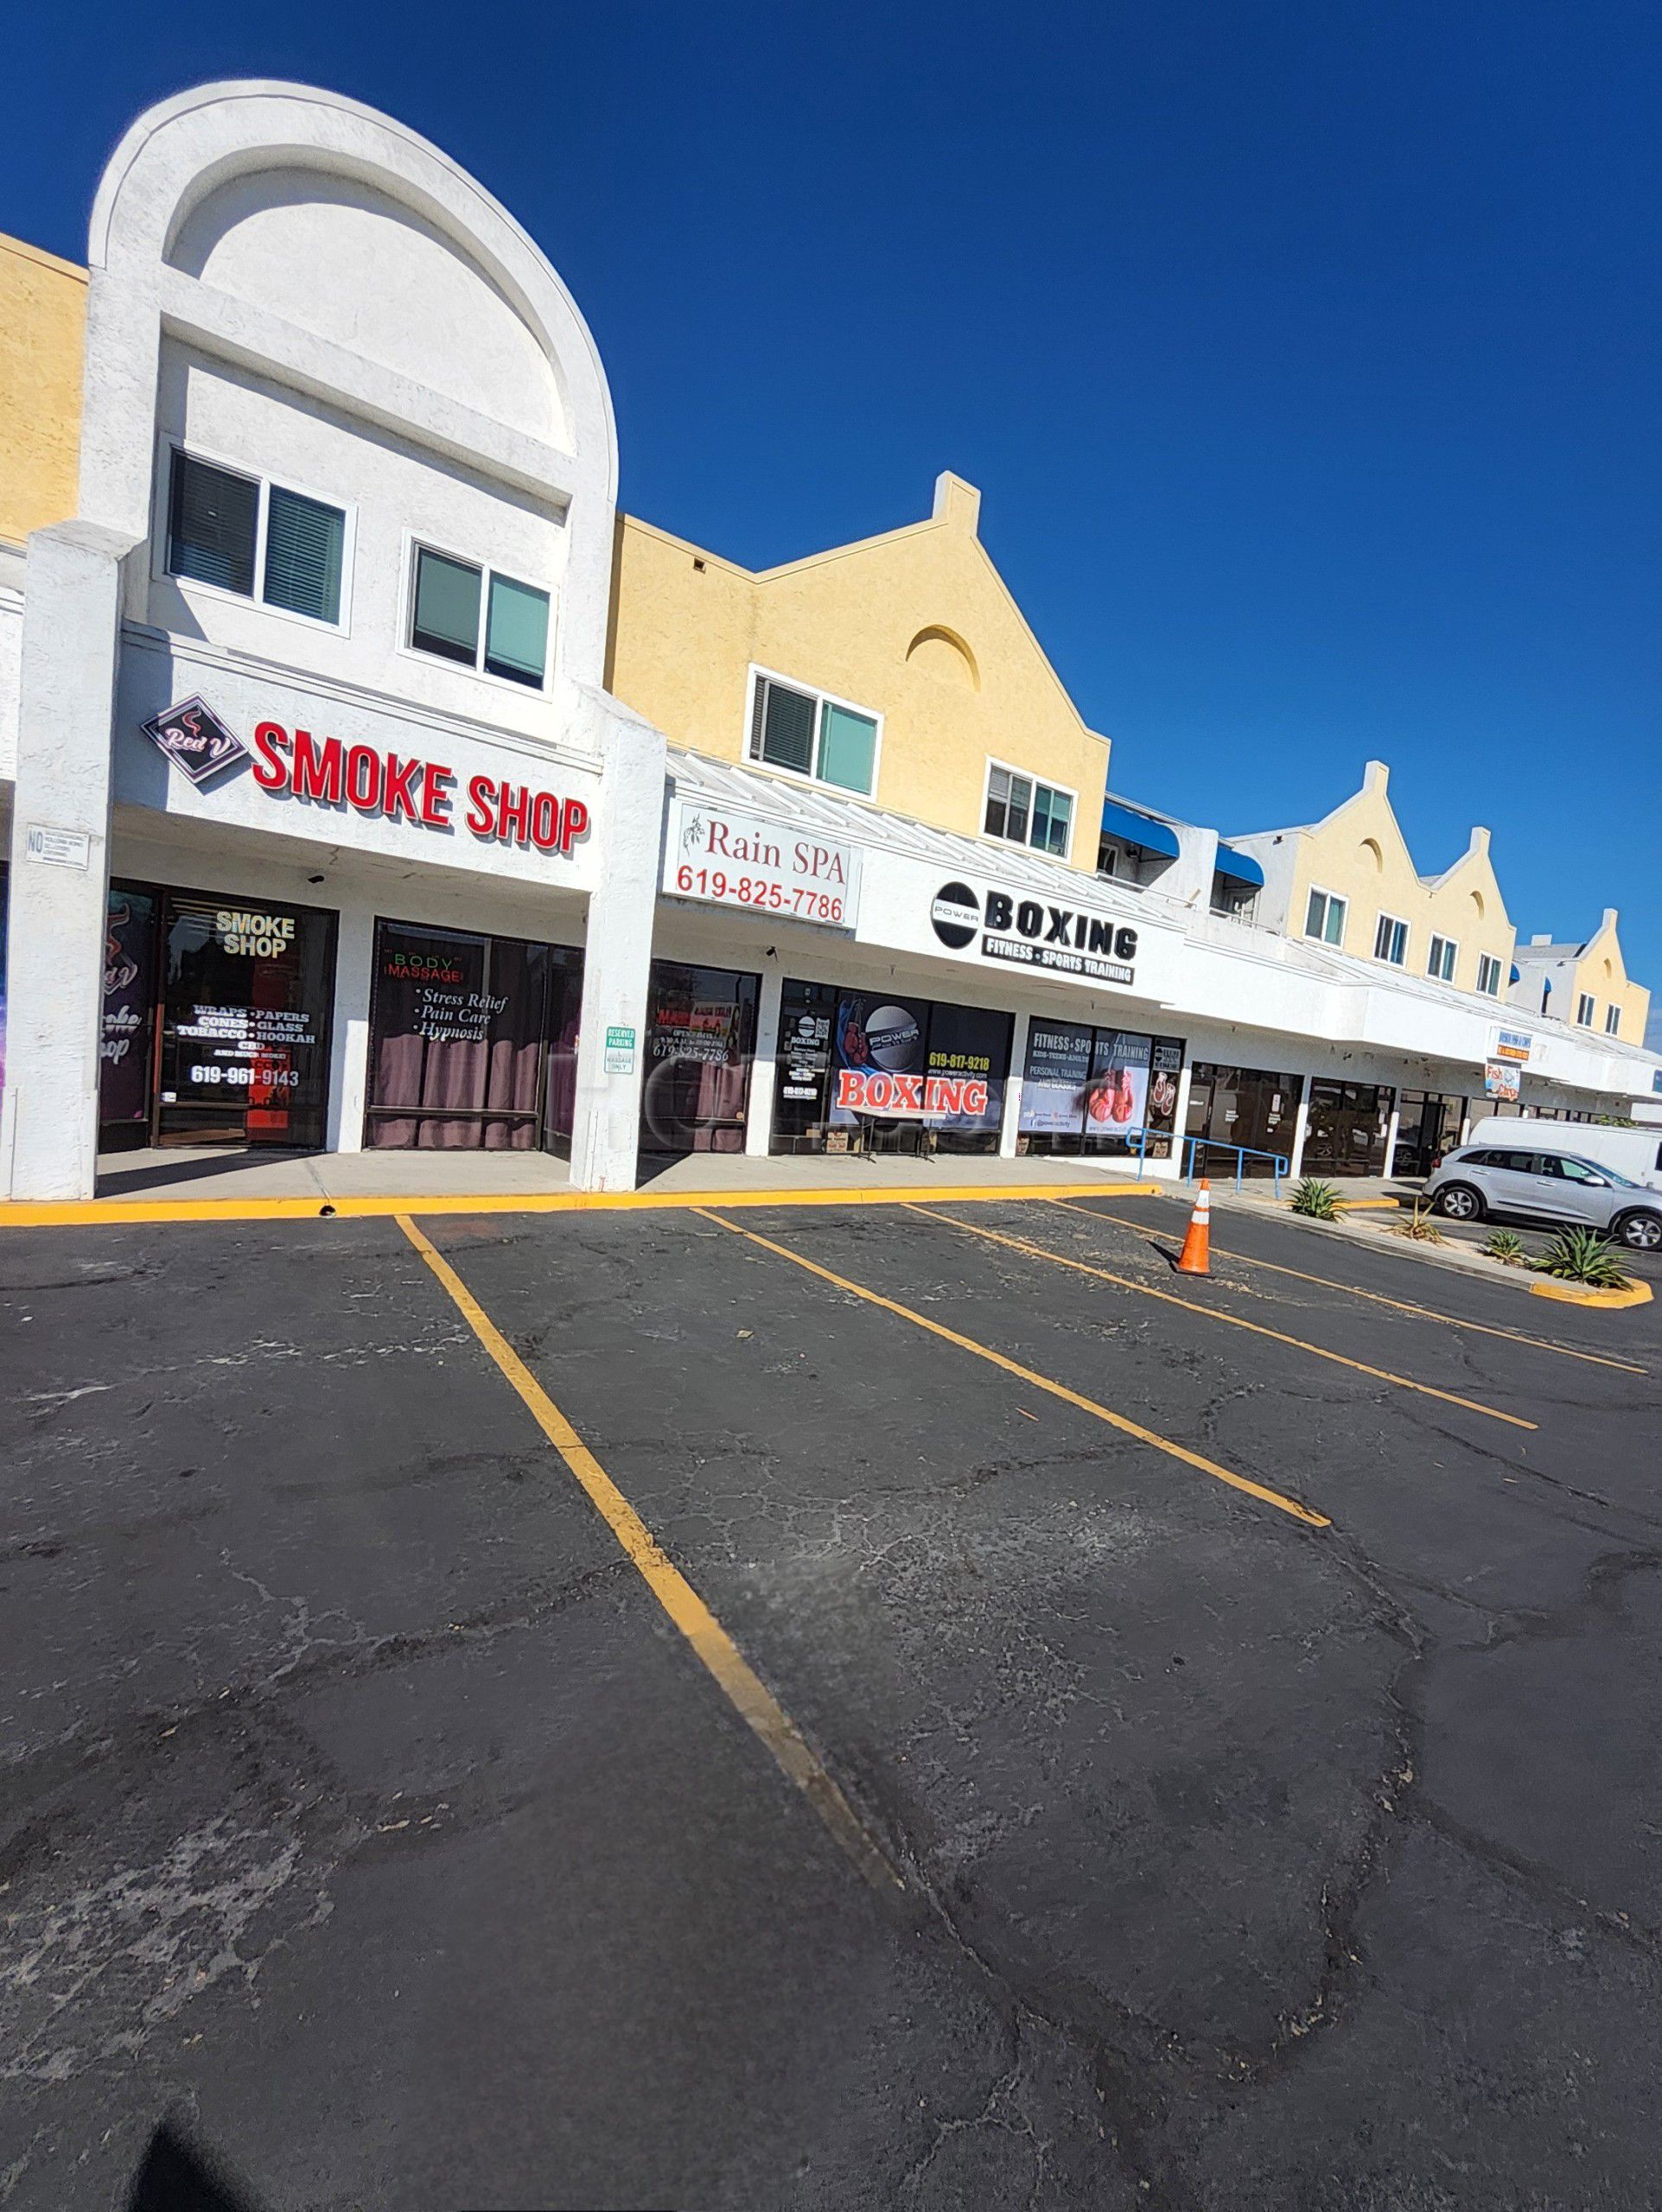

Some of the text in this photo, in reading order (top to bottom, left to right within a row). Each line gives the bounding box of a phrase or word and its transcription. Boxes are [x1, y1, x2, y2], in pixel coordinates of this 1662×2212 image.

[165, 728, 232, 759] Red V
[252, 721, 589, 853] SMOKE SHOP
[28, 830, 43, 854] NO
[705, 819, 845, 885] Rain SPA
[678, 865, 843, 921] 619-825-7786
[935, 907, 980, 922] POWER
[216, 911, 295, 939] SMOKE
[984, 890, 1138, 961] BOXING
[224, 934, 286, 958] SHOP
[395, 954, 452, 969] BODY
[987, 938, 1131, 982] FITNESS SPORTS TRAINING
[388, 963, 461, 982] MASSAGE
[423, 988, 508, 1014] Stress Relief
[193, 1005, 309, 1022] WRAPS PAPERS
[421, 1005, 491, 1025] Pain Care
[198, 1016, 303, 1033] CONES GLASS
[419, 1021, 484, 1041] Hypnosis
[608, 1028, 634, 1039] RESERVED
[176, 1025, 315, 1044] TOBACCO HOOKAH
[608, 1037, 633, 1047] PARKING
[791, 1036, 820, 1046] BOXING
[869, 1029, 920, 1046] POWER
[238, 1041, 265, 1051] CBD
[653, 1044, 729, 1061] 619-825-7786
[1034, 1033, 1070, 1051] FITNESS
[1112, 1043, 1149, 1060] TRAINING
[929, 1052, 990, 1071] 619-817-9218
[191, 1065, 299, 1087] 619-961-9143
[928, 1069, 988, 1079] www.poweractivity.com
[1029, 1065, 1086, 1080] PERSONAL TRAINING
[1037, 1078, 1051, 1088] AND
[837, 1071, 988, 1116] BOXING
